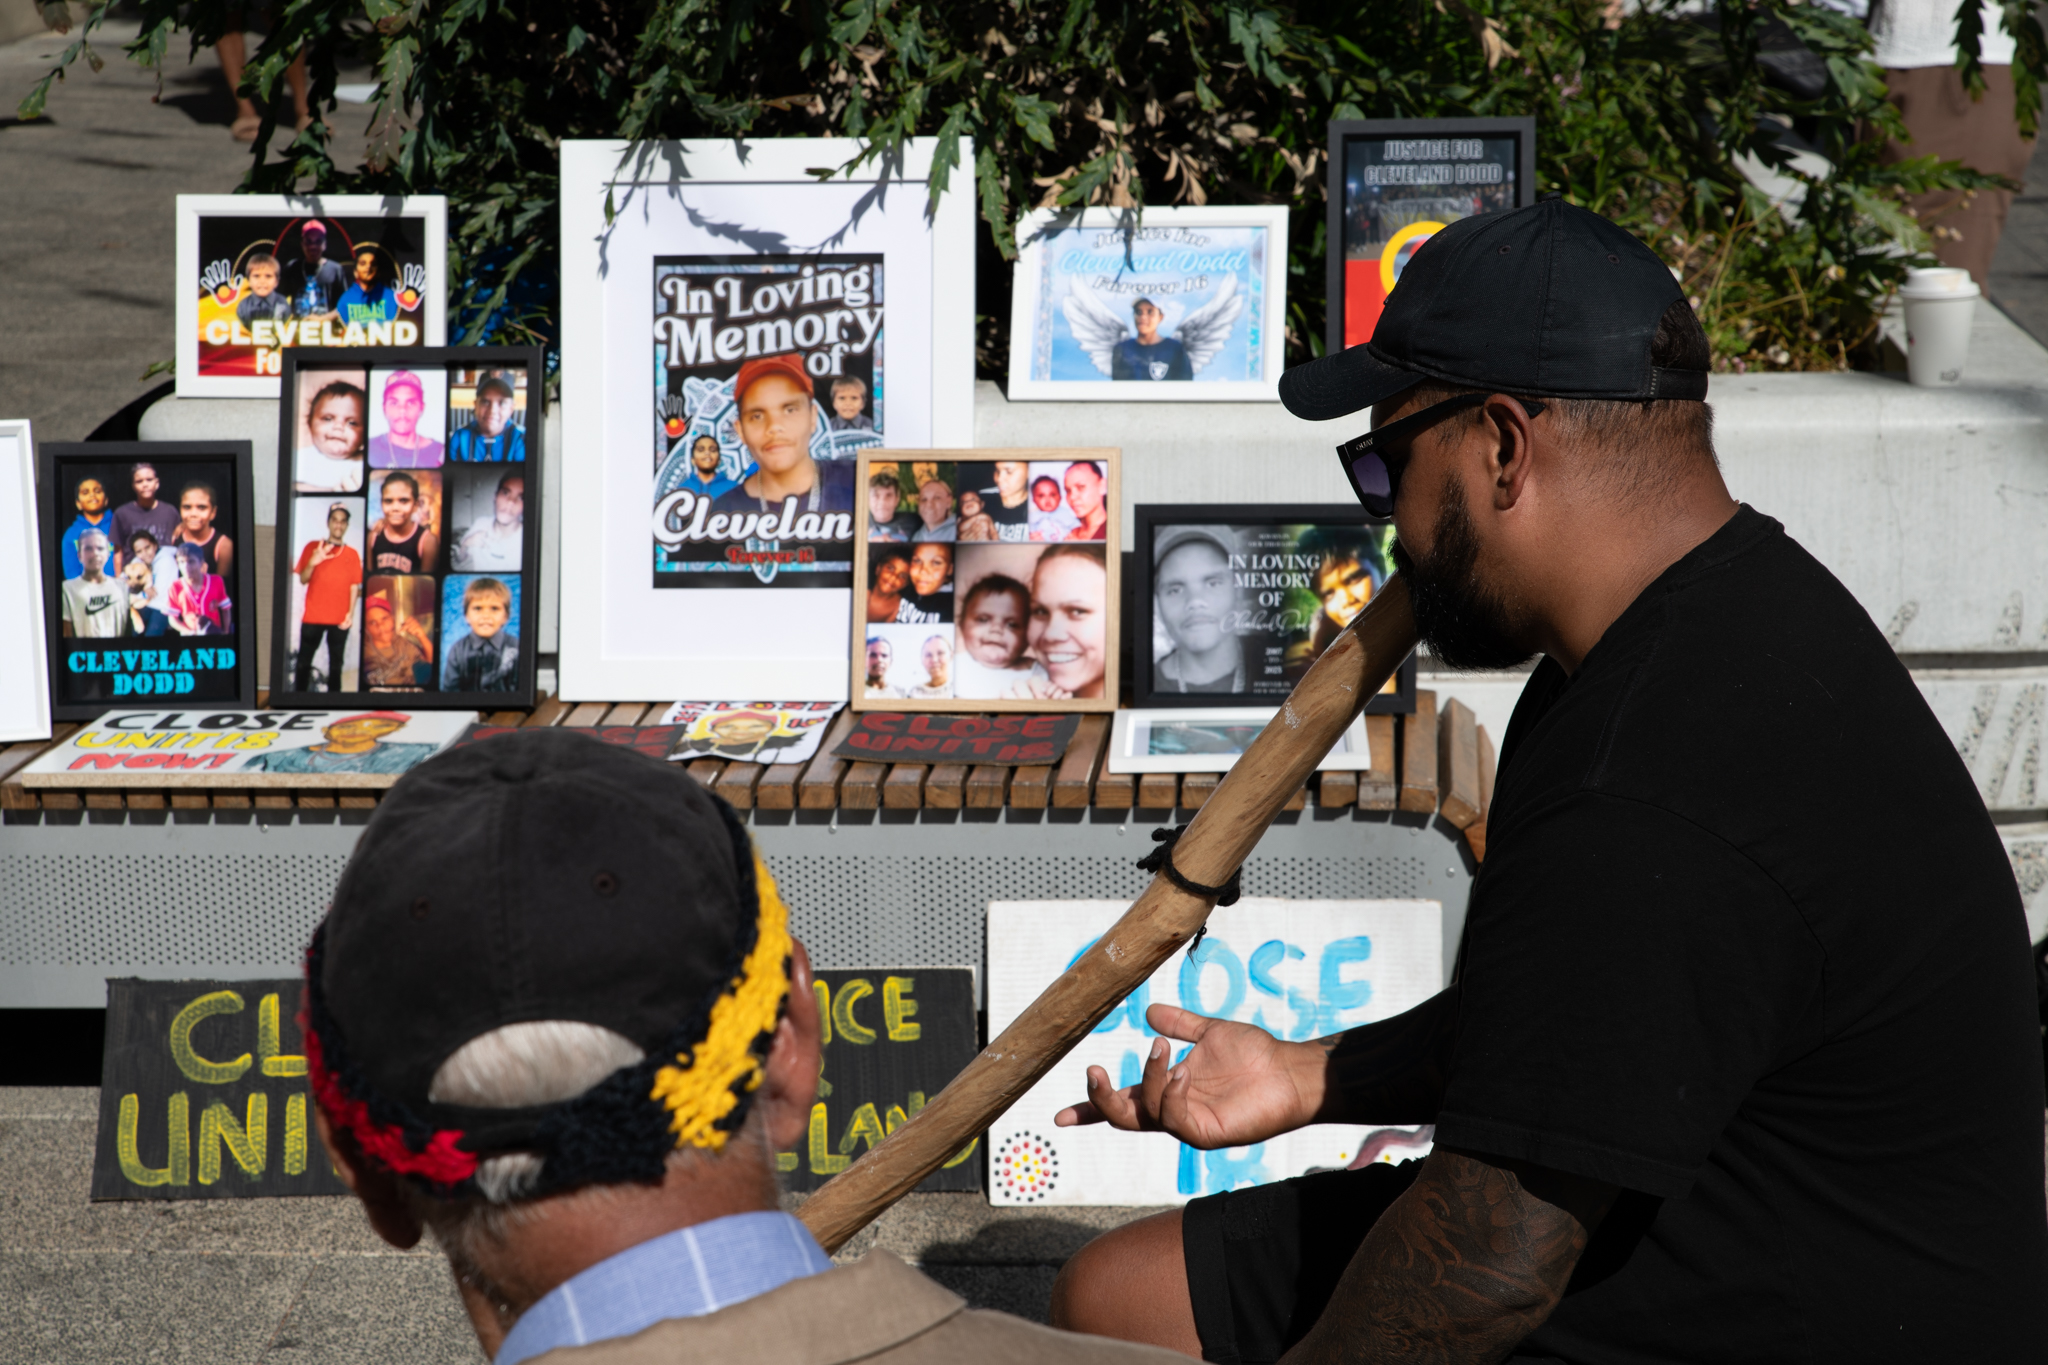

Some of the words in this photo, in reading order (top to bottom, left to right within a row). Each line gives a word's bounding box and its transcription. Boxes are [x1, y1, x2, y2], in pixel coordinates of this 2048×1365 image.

[1383, 140, 1450, 160] JUSTICE
[1451, 139, 1483, 159] FOR
[1364, 165, 1454, 185] CLEVELAND
[1455, 164, 1502, 184] DODD
[1177, 249, 1247, 273] Dodd
[662, 276, 714, 314] In
[714, 264, 871, 318] Loving
[1184, 273, 1209, 293] 16
[205, 320, 418, 347] CLEVELAND
[654, 307, 885, 367] Memory
[807, 342, 850, 377] of
[1355, 437, 1374, 451] QUAY
[726, 546, 793, 564] Forever
[797, 547, 816, 564] 16
[1228, 554, 1248, 570] IN
[1252, 554, 1321, 570] LOVING
[1234, 573, 1314, 588] MEMORY
[1258, 591, 1285, 607] OF
[67, 648, 237, 673] CLEVELAND
[113, 672, 196, 696] DODD
[104, 713, 329, 730] CLOSE
[861, 713, 1066, 738] CLOSE
[848, 732, 1011, 754] UNIT
[67, 752, 239, 771] NOW!
[117, 1090, 341, 1188] UNI
